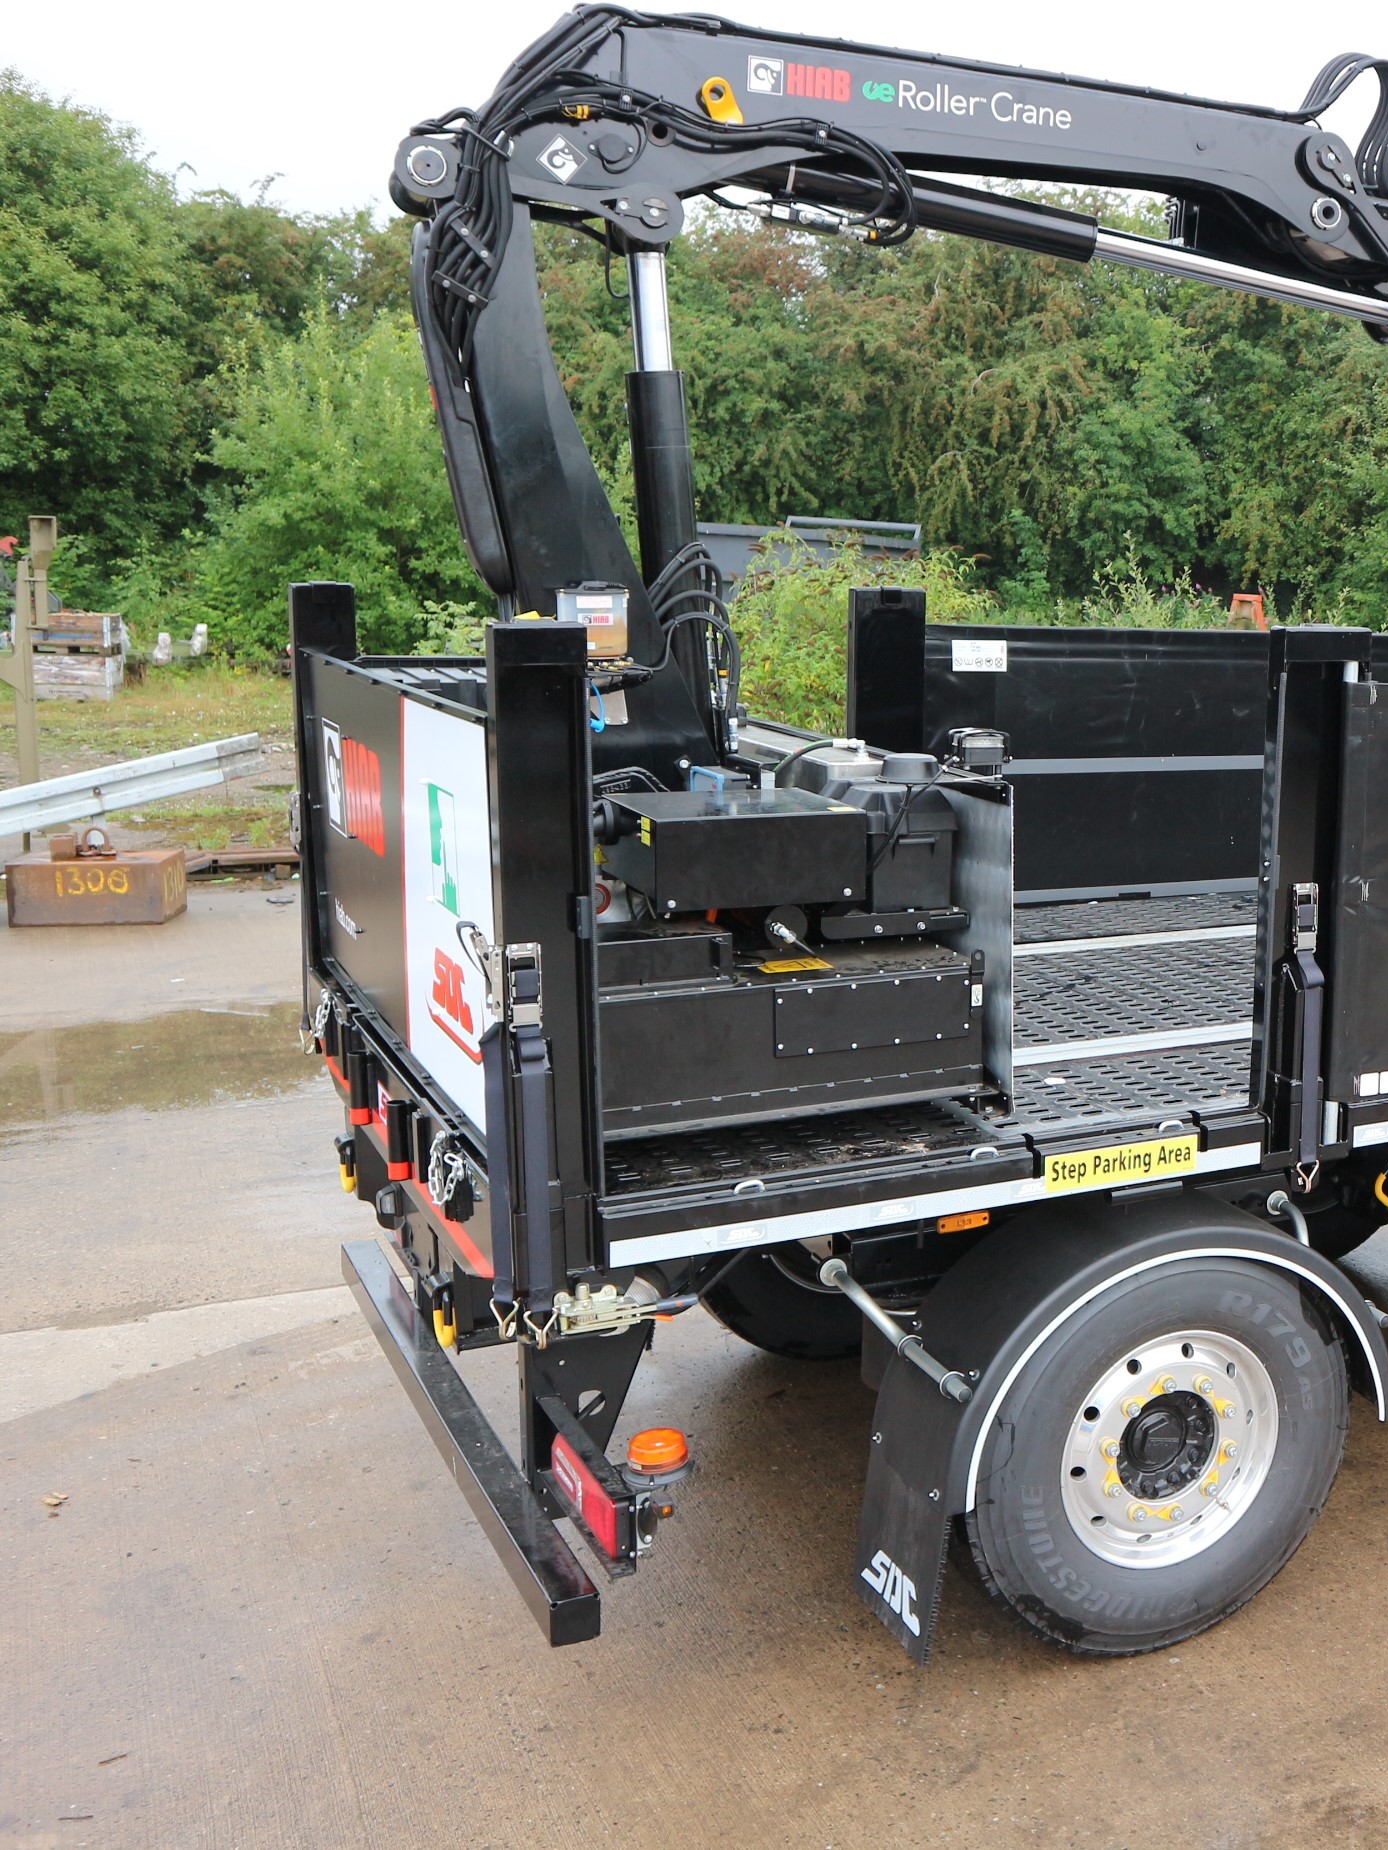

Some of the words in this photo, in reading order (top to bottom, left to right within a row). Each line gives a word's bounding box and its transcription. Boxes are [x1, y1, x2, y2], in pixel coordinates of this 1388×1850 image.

[787, 63, 853, 102] HIAB
[991, 92, 1072, 129] Crane
[593, 615, 610, 624] HIAB
[432, 947, 474, 1035] SDC
[1052, 1161, 1087, 1183] Step
[1093, 1149, 1152, 1173] Parking
[1157, 1145, 1191, 1166] Area
[1215, 1289, 1312, 1368] R179
[860, 1549, 921, 1637] SDC
